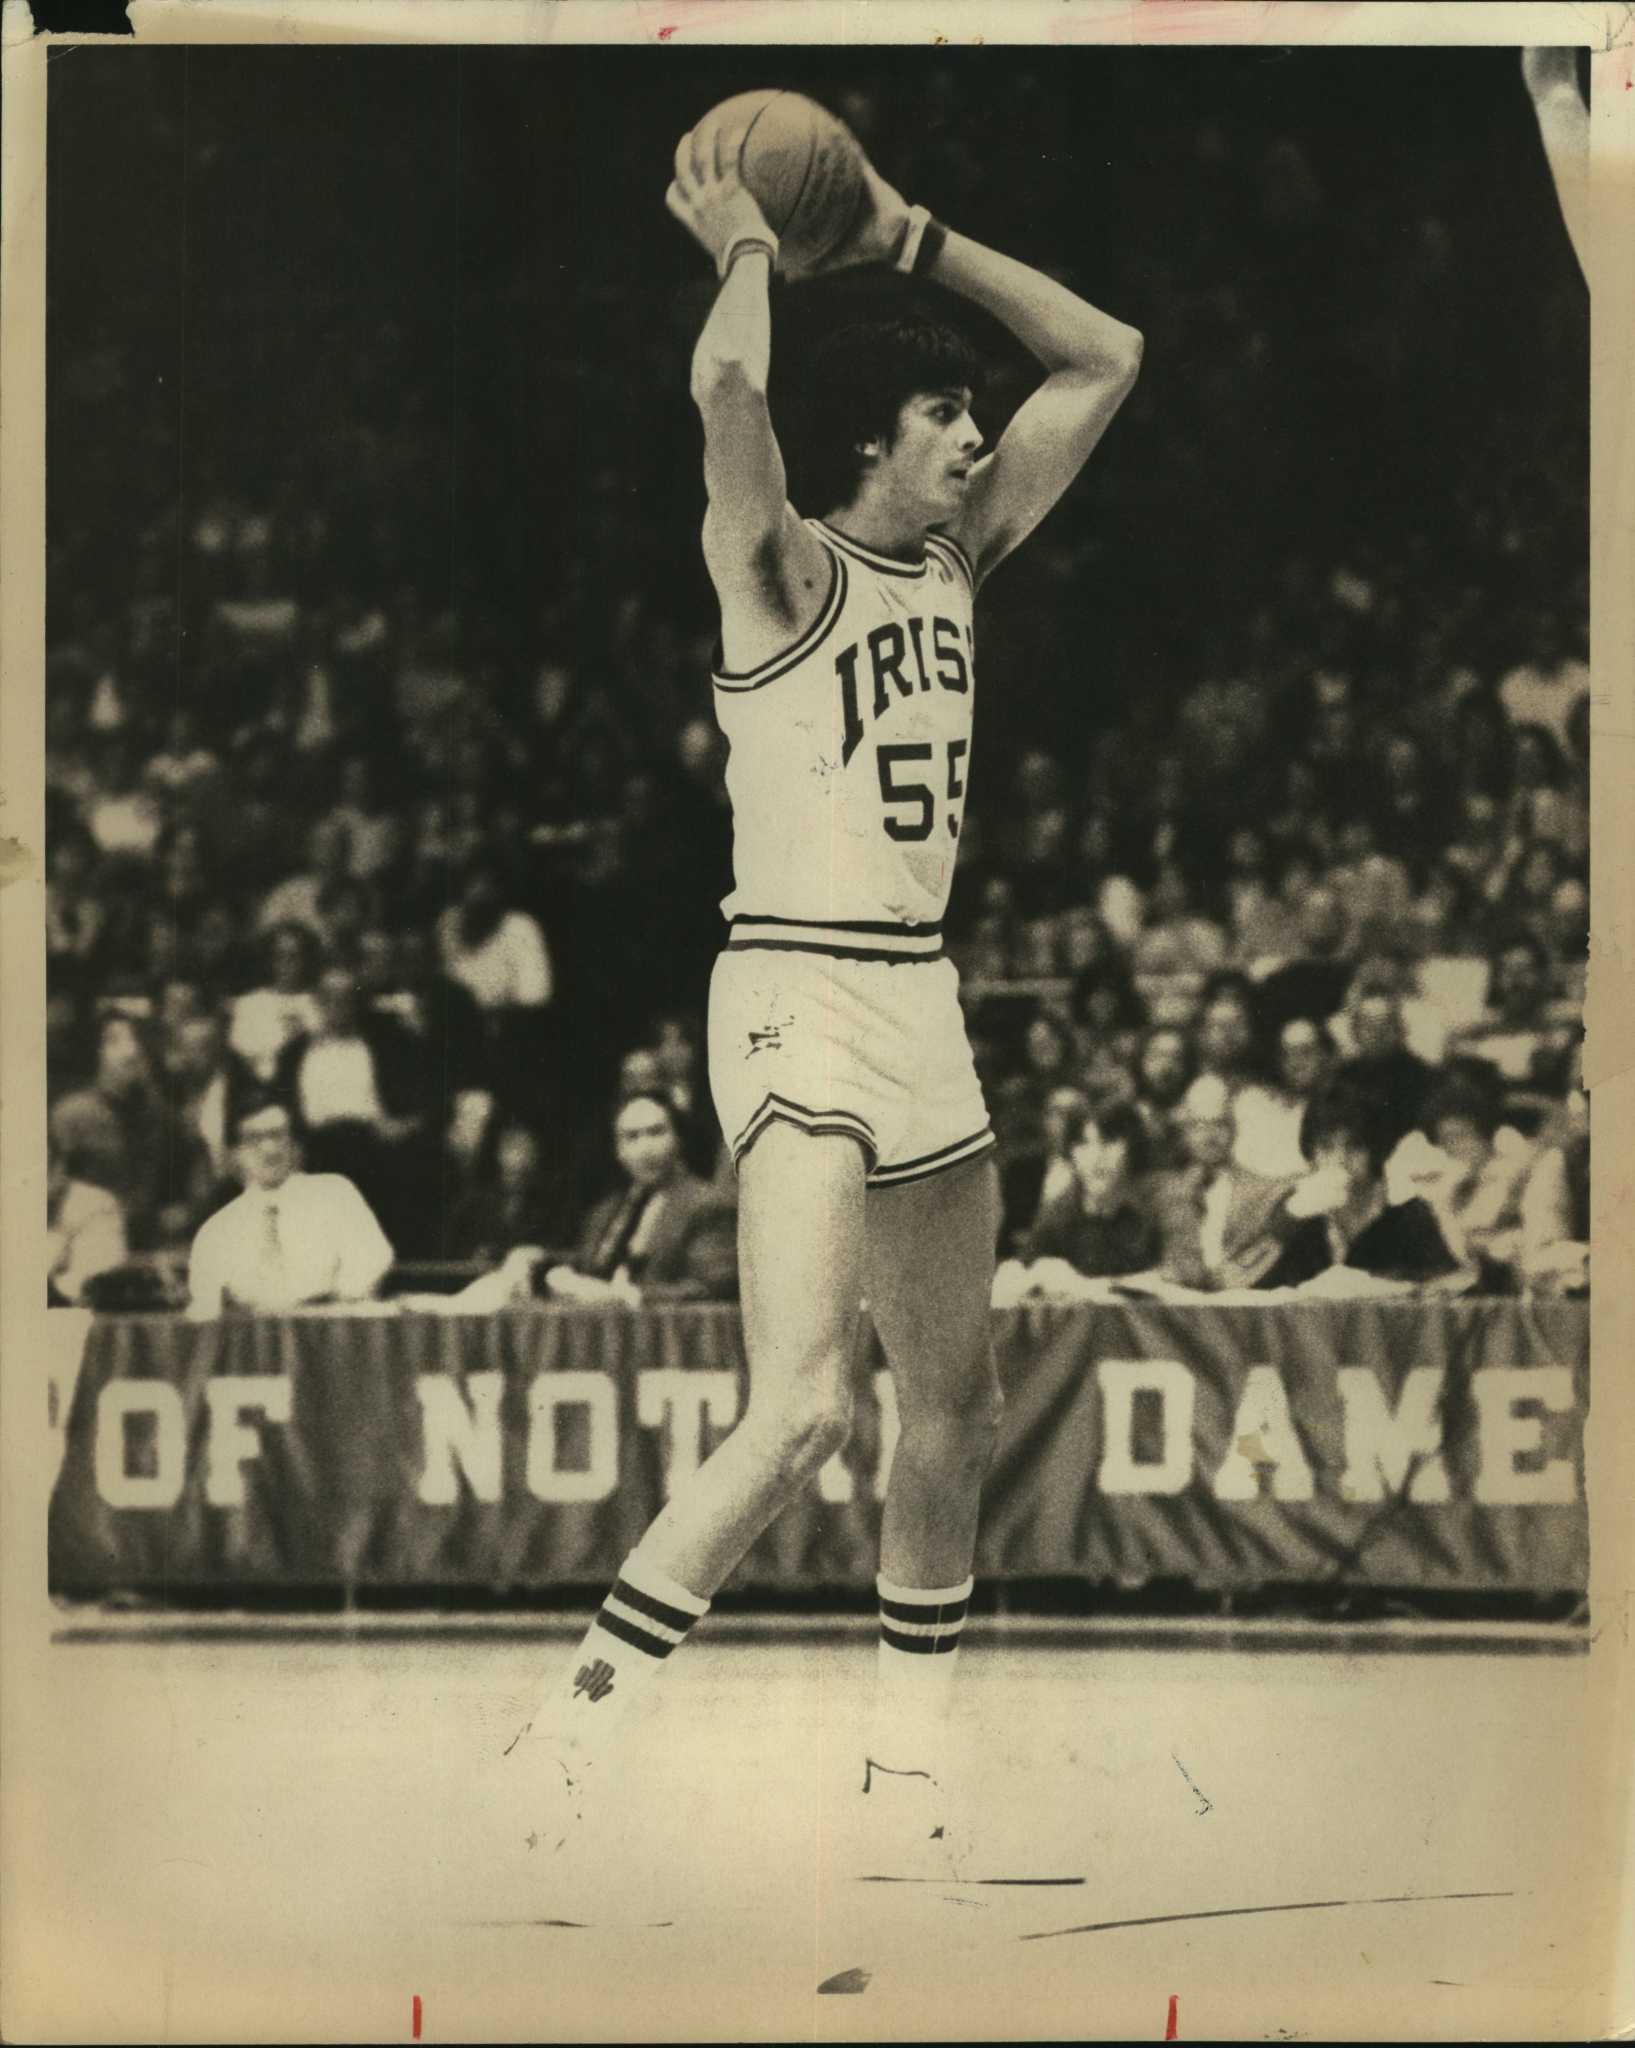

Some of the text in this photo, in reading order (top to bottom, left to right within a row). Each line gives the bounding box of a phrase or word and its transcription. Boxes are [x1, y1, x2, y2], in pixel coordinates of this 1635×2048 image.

[835, 615, 974, 769] IRIS
[96, 1358, 1578, 1509] OF NOT DAME
